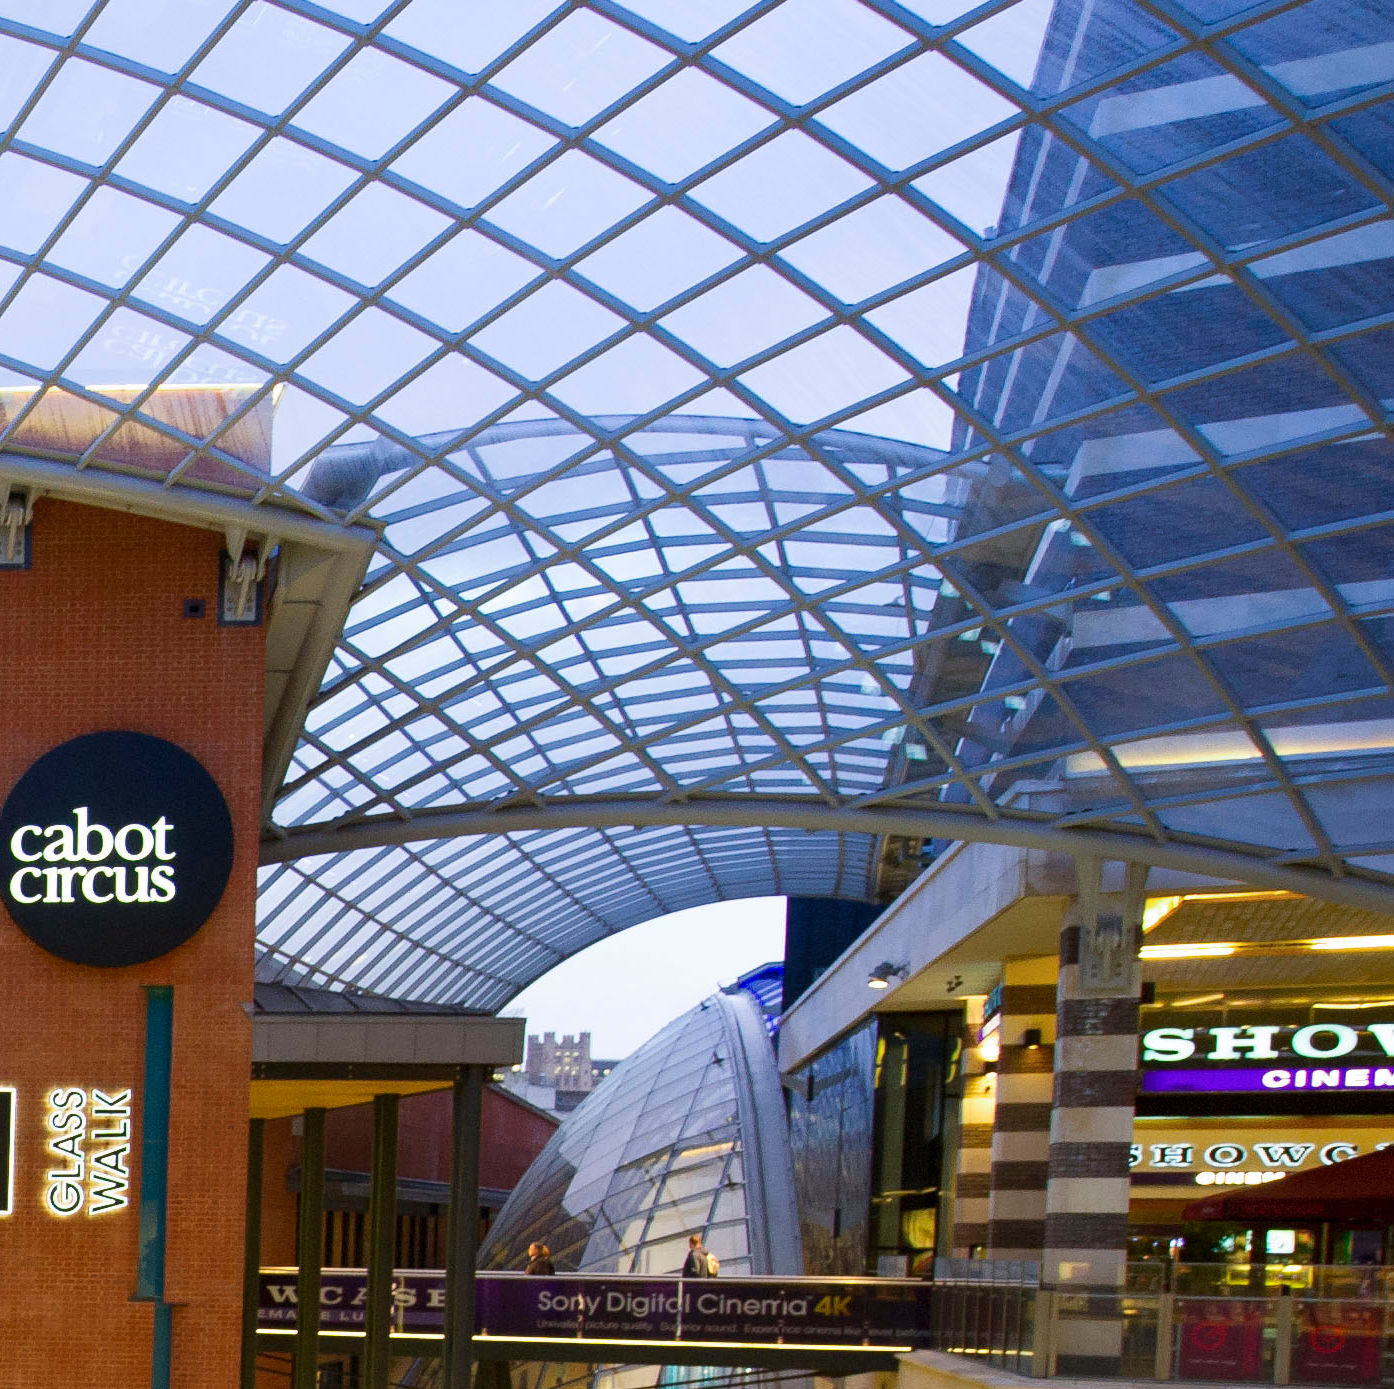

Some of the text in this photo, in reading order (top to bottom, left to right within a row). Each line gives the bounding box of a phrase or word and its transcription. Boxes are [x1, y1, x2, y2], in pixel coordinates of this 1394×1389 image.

[10, 806, 177, 863] cabot
[10, 865, 177, 904] circus
[48, 1087, 86, 1214] GLASS
[88, 1088, 132, 1216] WALK
[537, 1290, 852, 1318] Sony Digital Cinema 4K
